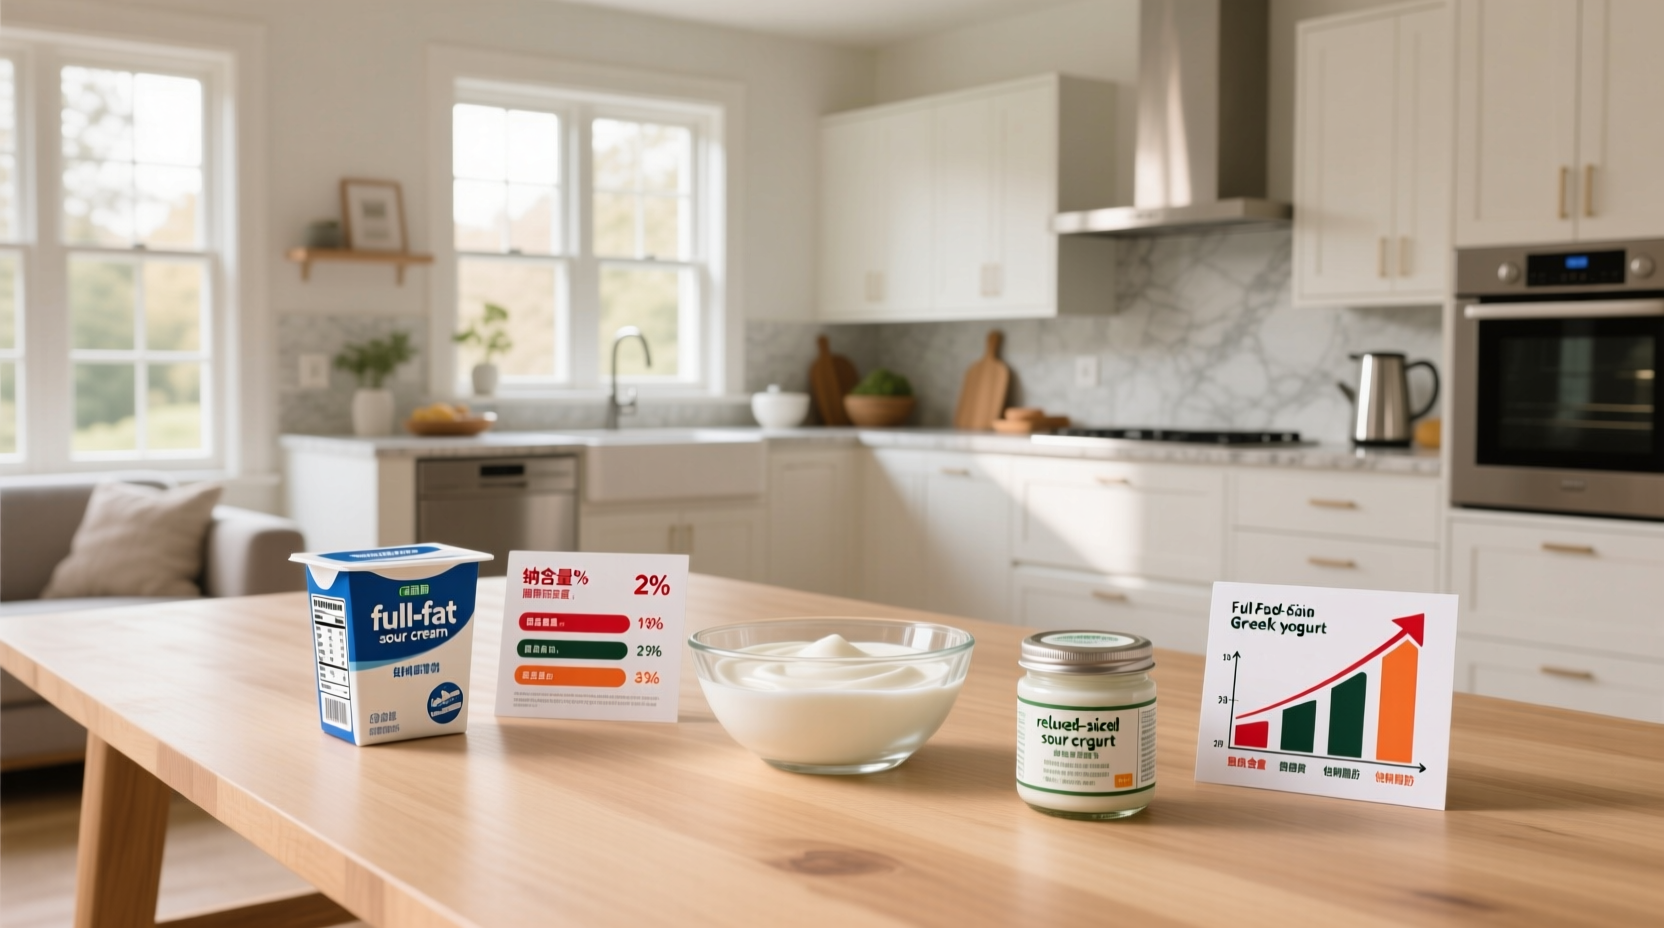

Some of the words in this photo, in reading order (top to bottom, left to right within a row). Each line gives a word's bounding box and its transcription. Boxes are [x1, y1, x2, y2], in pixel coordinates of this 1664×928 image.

[634, 574, 671, 596] 2%
[371, 600, 457, 631] full-fat
[379, 632, 408, 644] sour
[411, 628, 448, 641] cream
[1230, 616, 1276, 631] Greek
[1280, 621, 1328, 637] yogurt
[1041, 734, 1069, 746] sour
[1071, 735, 1116, 751] crgurt
